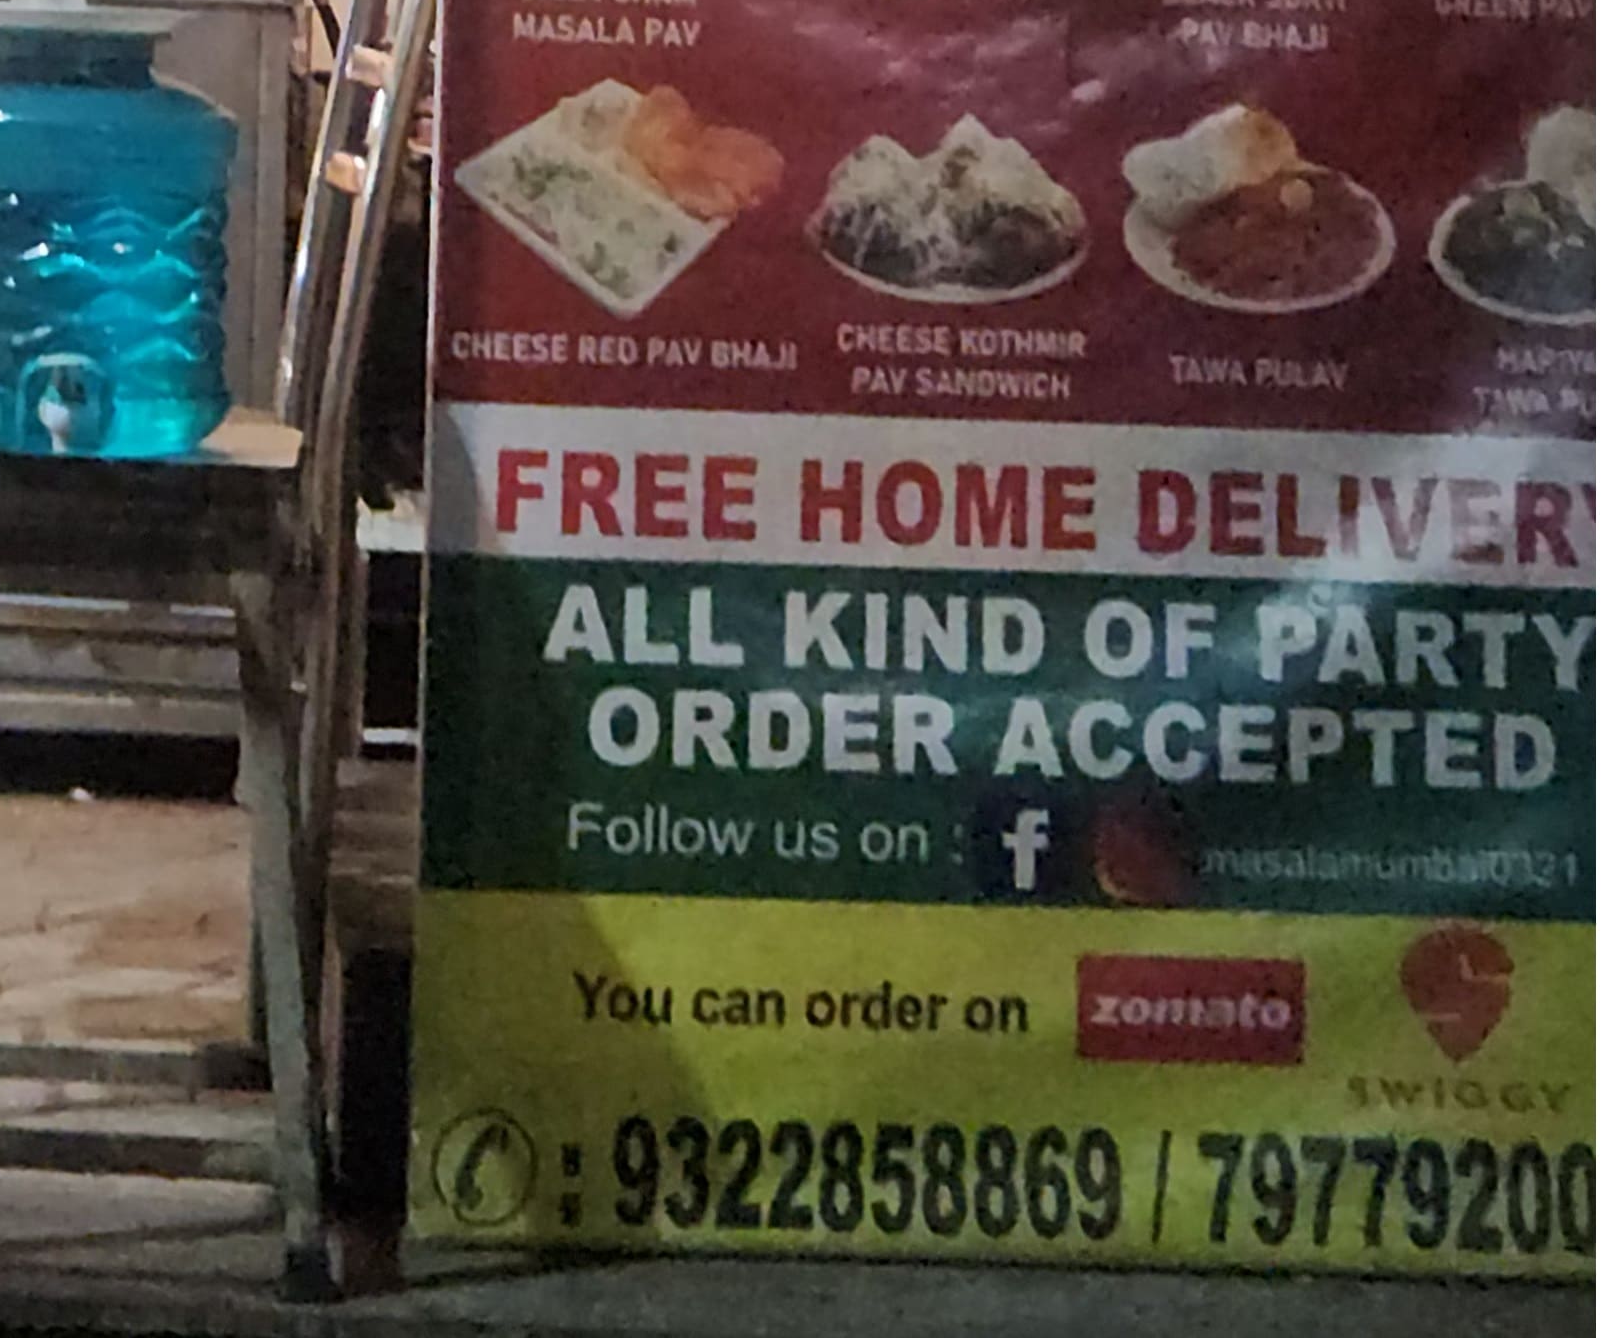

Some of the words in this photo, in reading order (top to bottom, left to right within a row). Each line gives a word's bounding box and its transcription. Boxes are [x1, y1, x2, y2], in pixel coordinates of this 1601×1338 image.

[512, 12, 635, 45] MASALA
[645, 18, 701, 46] PAV
[1180, 16, 1233, 46] PAV
[1243, 21, 1329, 51] BHAJI
[452, 331, 568, 363] CHEESE
[578, 334, 639, 366] RED
[646, 336, 702, 367] PAV
[711, 340, 798, 370] BHAJI
[837, 323, 950, 355] CHEESE
[959, 327, 1087, 358] KOTHMIR
[851, 366, 907, 394] PAV
[915, 367, 1071, 400] SANDWICH
[1169, 354, 1248, 386] TAWA
[1255, 357, 1349, 391] PULAV
[496, 448, 758, 542] FREE
[799, 458, 1098, 551] HOME
[542, 584, 745, 668] ALL
[784, 590, 1046, 675] KIND
[1084, 599, 1216, 679] OF
[1256, 603, 1596, 691] PARTY
[588, 686, 958, 776] ORDER
[993, 696, 1557, 791] ACCEPTED
[567, 800, 754, 857] Follow
[773, 818, 841, 863] us
[860, 821, 929, 865] on
[572, 972, 673, 1025] You
[691, 984, 787, 1029] can
[805, 981, 948, 1032] order
[963, 991, 1030, 1034] on
[1090, 991, 1292, 1027] zomato
[1347, 1076, 1571, 1113] SWIGGY
[612, 1115, 1124, 1240] 9322858869
